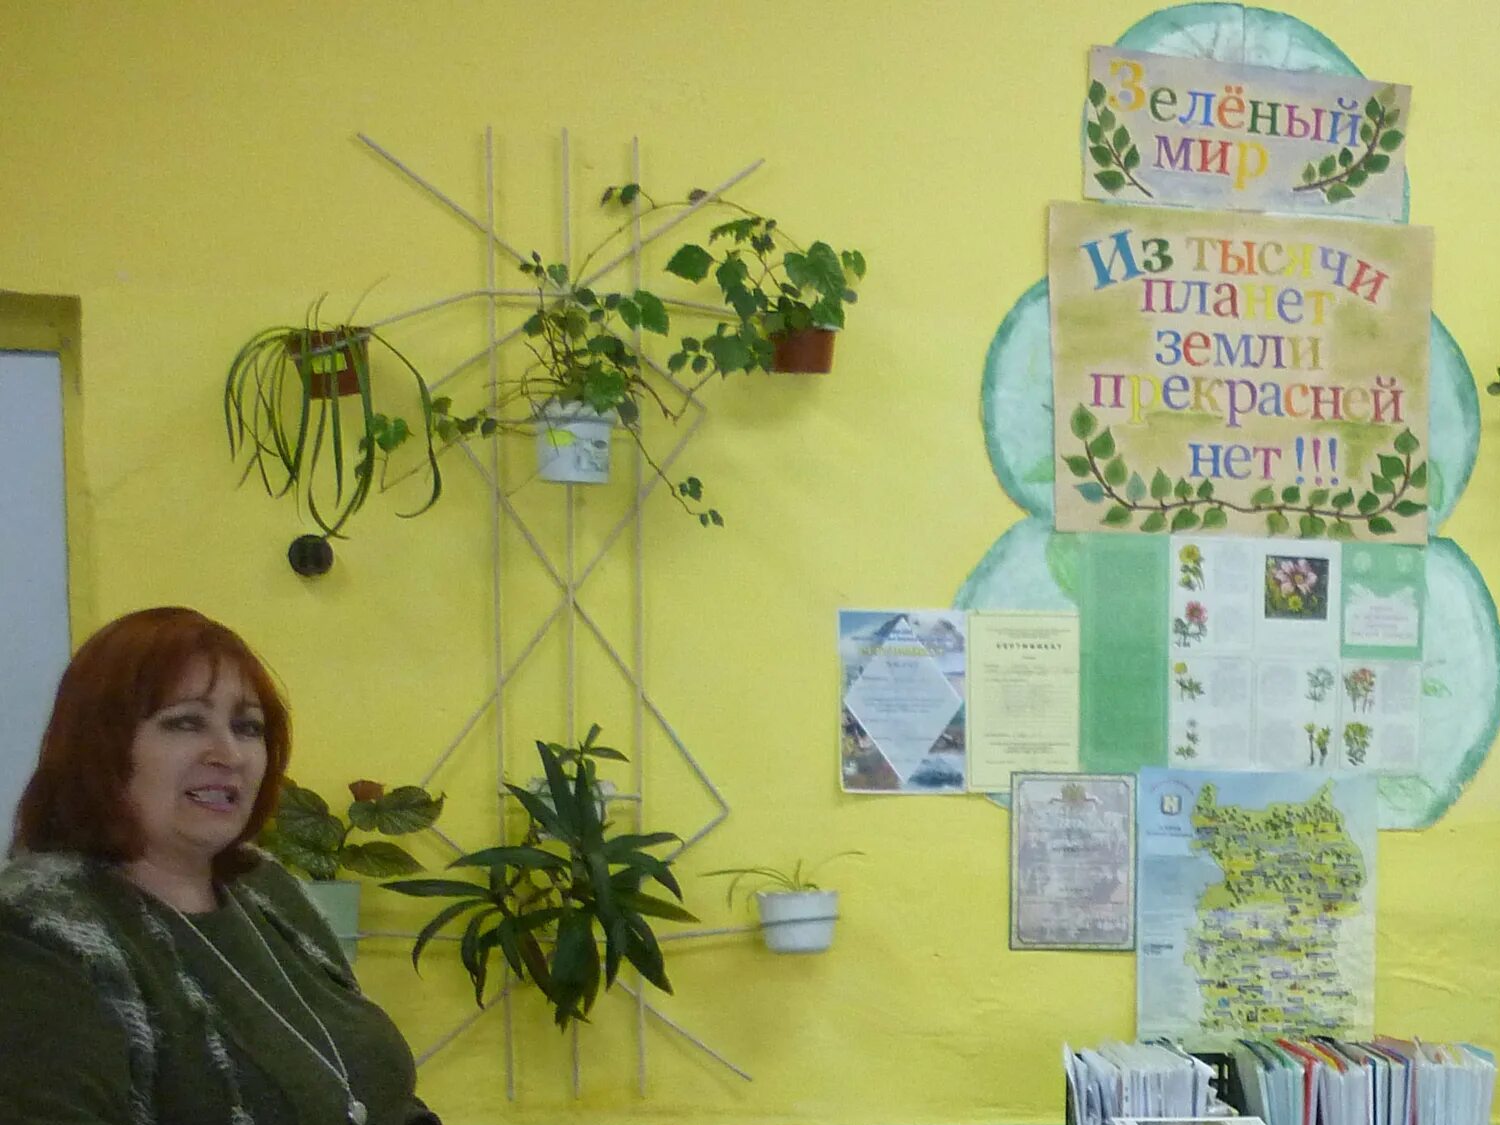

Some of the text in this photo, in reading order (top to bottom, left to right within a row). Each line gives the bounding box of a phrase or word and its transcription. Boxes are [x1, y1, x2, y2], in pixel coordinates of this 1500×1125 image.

[1107, 60, 1362, 148] Зелёный
[1153, 134, 1270, 191] мир
[1080, 229, 1390, 304] Из тысячи
[1140, 277, 1336, 325] планет
[1155, 329, 1323, 370] земли
[1090, 373, 1405, 428] прекрасней
